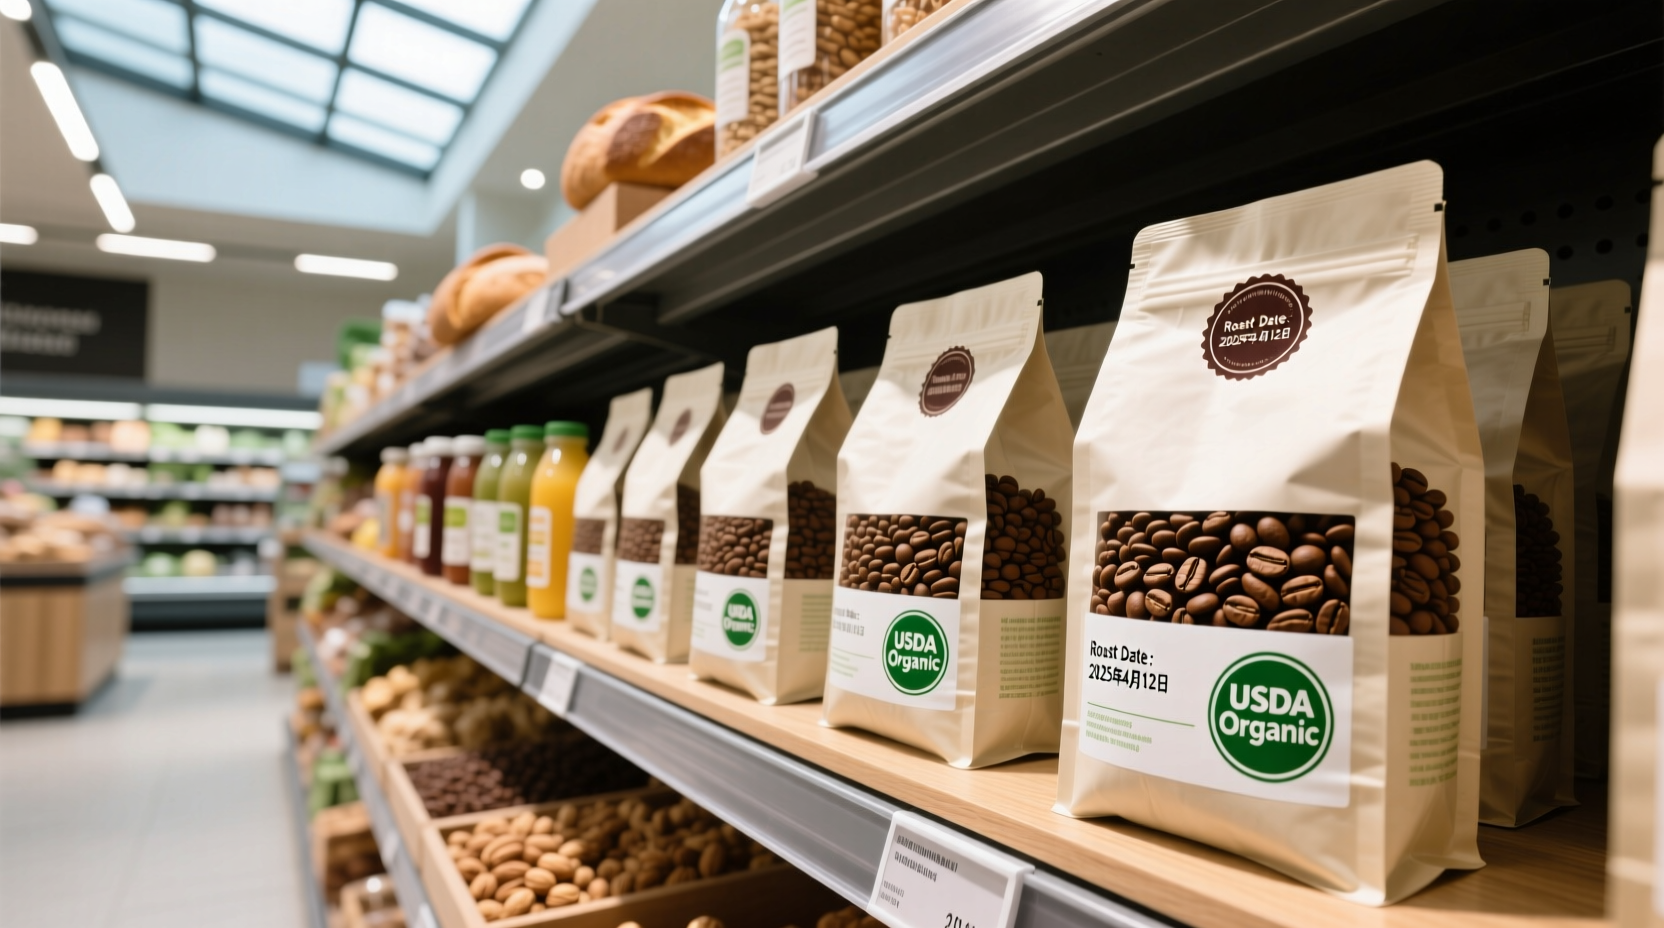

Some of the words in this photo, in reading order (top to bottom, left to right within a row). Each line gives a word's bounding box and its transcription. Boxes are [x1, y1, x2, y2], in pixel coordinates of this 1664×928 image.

[894, 630, 938, 654] USDA
[1090, 639, 1119, 660] Roast
[887, 649, 941, 673] Organic
[1088, 663, 1168, 694] 2025年4月12日
[1230, 683, 1315, 719] USDA
[1219, 710, 1320, 747] Organic
